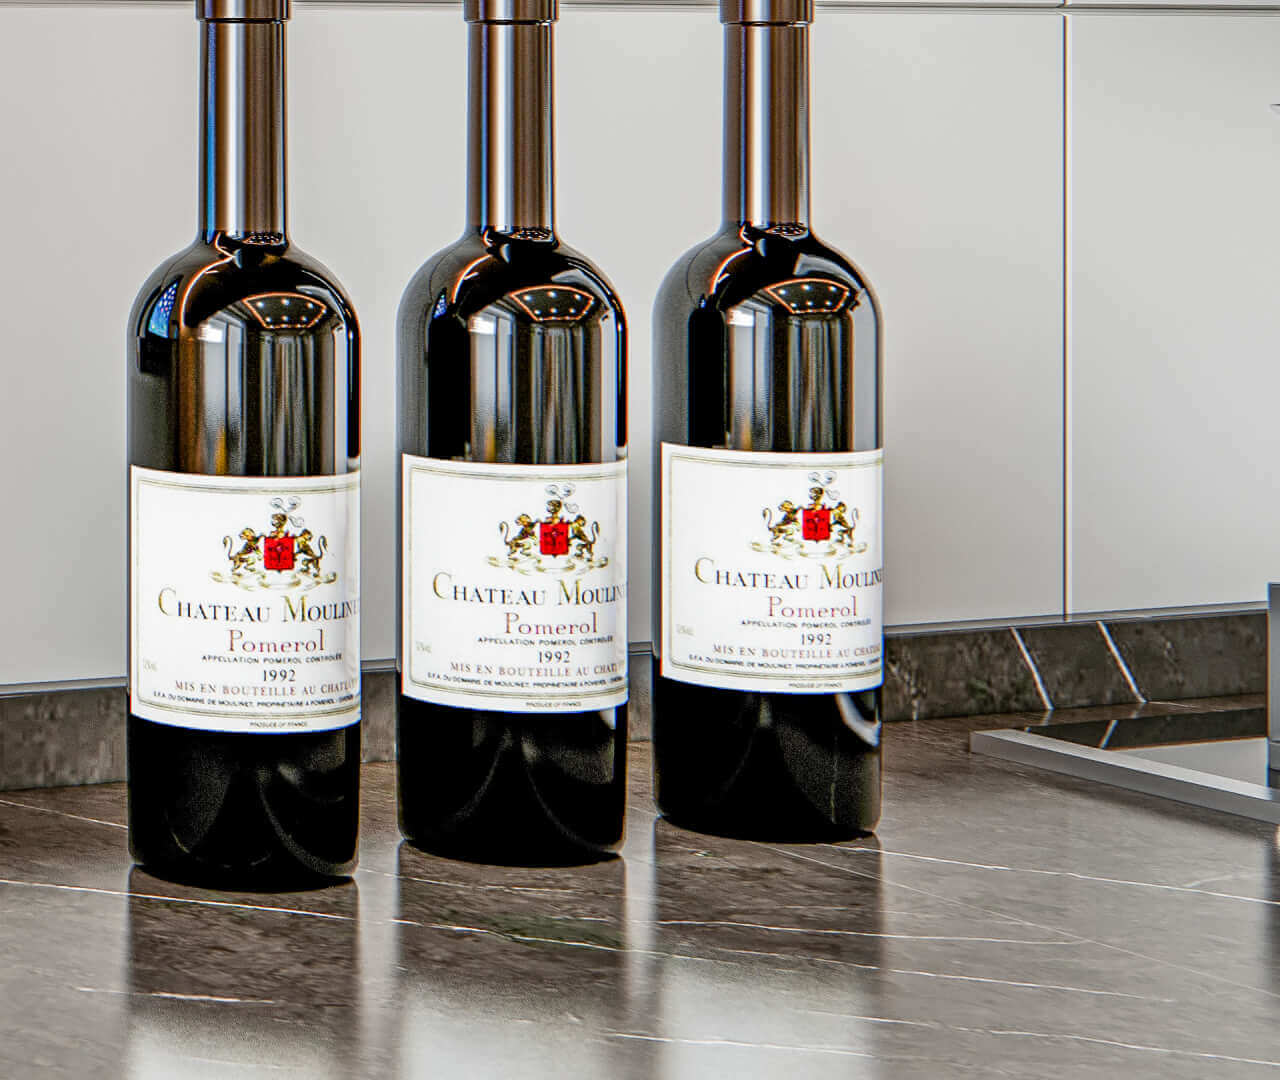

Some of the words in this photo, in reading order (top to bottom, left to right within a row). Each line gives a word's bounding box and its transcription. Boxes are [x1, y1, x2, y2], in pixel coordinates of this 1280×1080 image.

[694, 557, 808, 589] CHATEAU
[432, 571, 546, 606] CHATEAU
[158, 587, 271, 623] CHATEAU
[768, 595, 858, 618] Pomerol
[503, 611, 599, 635] Pomerol
[227, 628, 325, 653] Pomerol
[801, 633, 832, 646] 1992
[538, 651, 571, 663] 1992
[713, 644, 734, 655] MIS
[739, 646, 756, 656] EN
[762, 648, 832, 659] BOUTEILLE
[837, 648, 850, 658] AU
[263, 669, 297, 682] 1992
[450, 662, 471, 673] MIS
[476, 664, 493, 674] EN
[498, 667, 570, 677] BOUTEILLE
[576, 666, 590, 676] AU
[175, 679, 195, 692] MIS
[201, 684, 216, 694] EN
[222, 686, 297, 697] BOUTEILLE
[303, 685, 318, 696] AU
